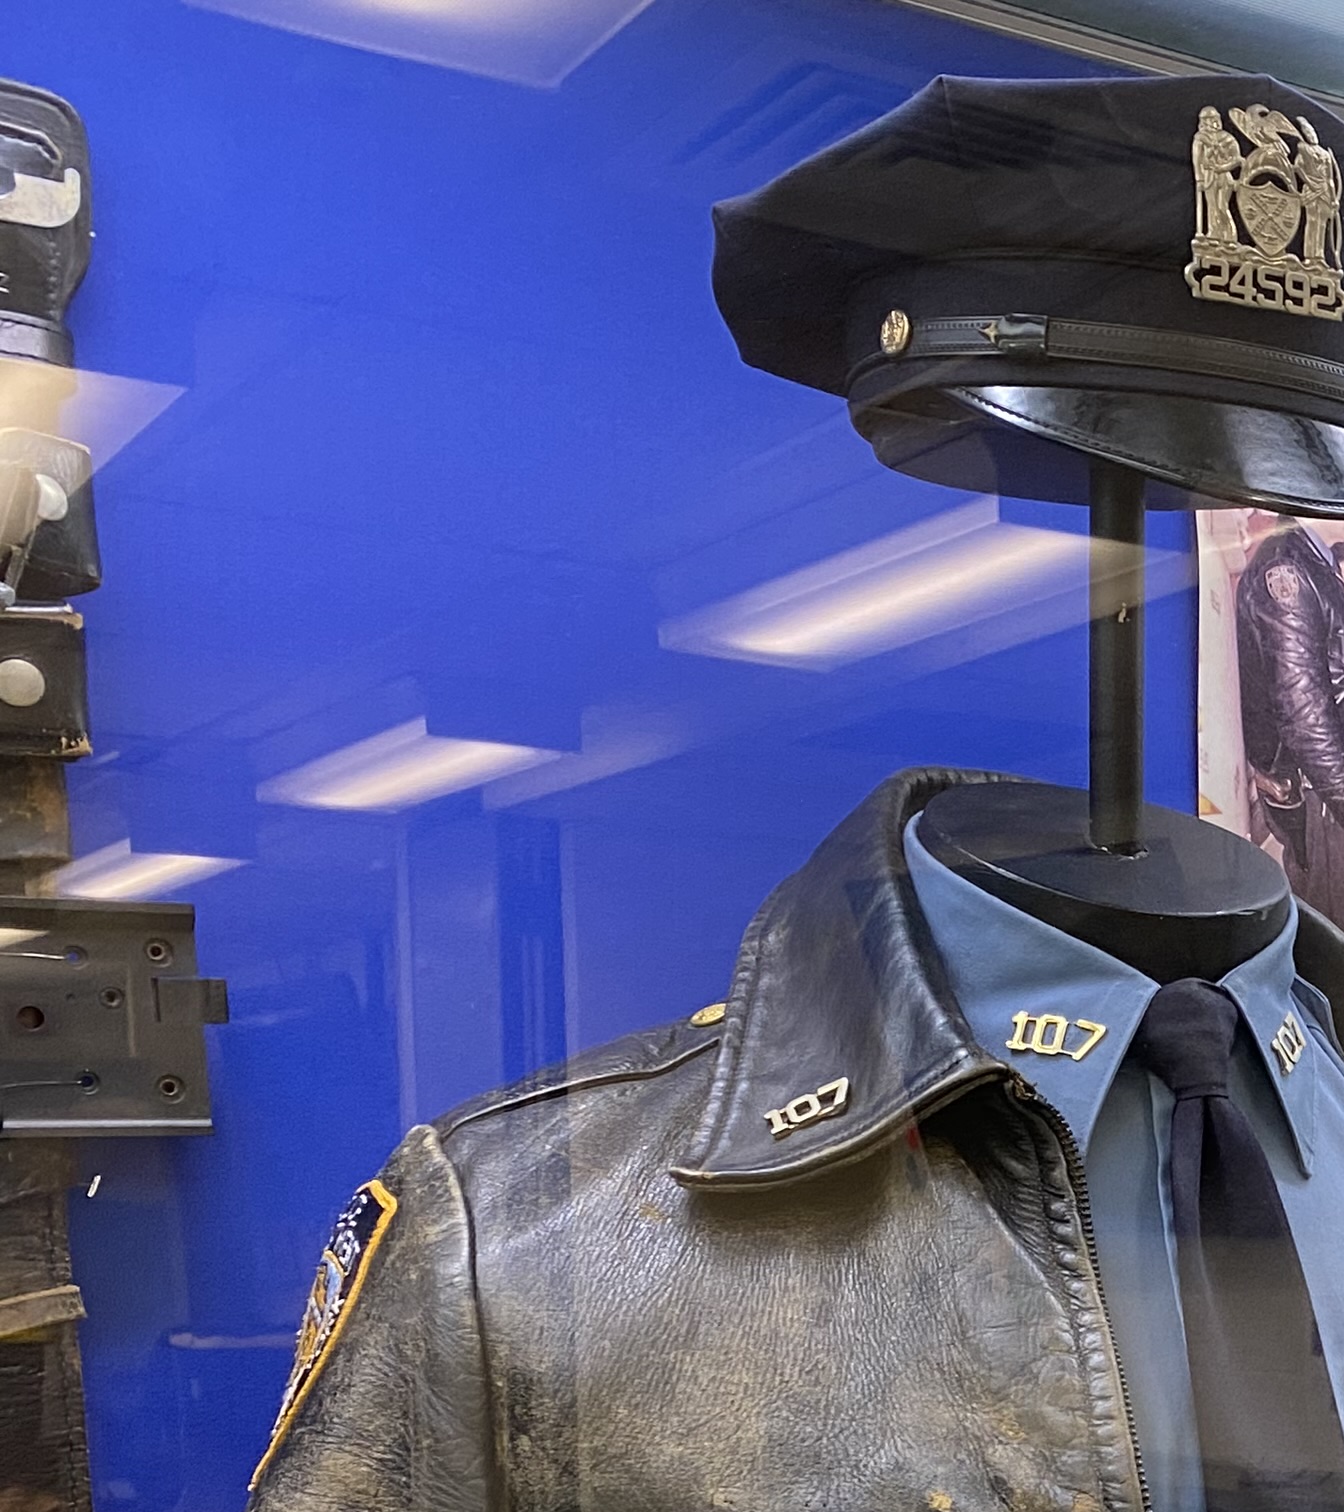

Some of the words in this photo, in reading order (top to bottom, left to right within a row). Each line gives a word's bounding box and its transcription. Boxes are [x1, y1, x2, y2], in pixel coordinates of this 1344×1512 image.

[1202, 260, 1337, 315] 24592
[1006, 1010, 1107, 1061] 107
[1270, 1010, 1308, 1075] 107
[763, 1076, 850, 1139] 107
